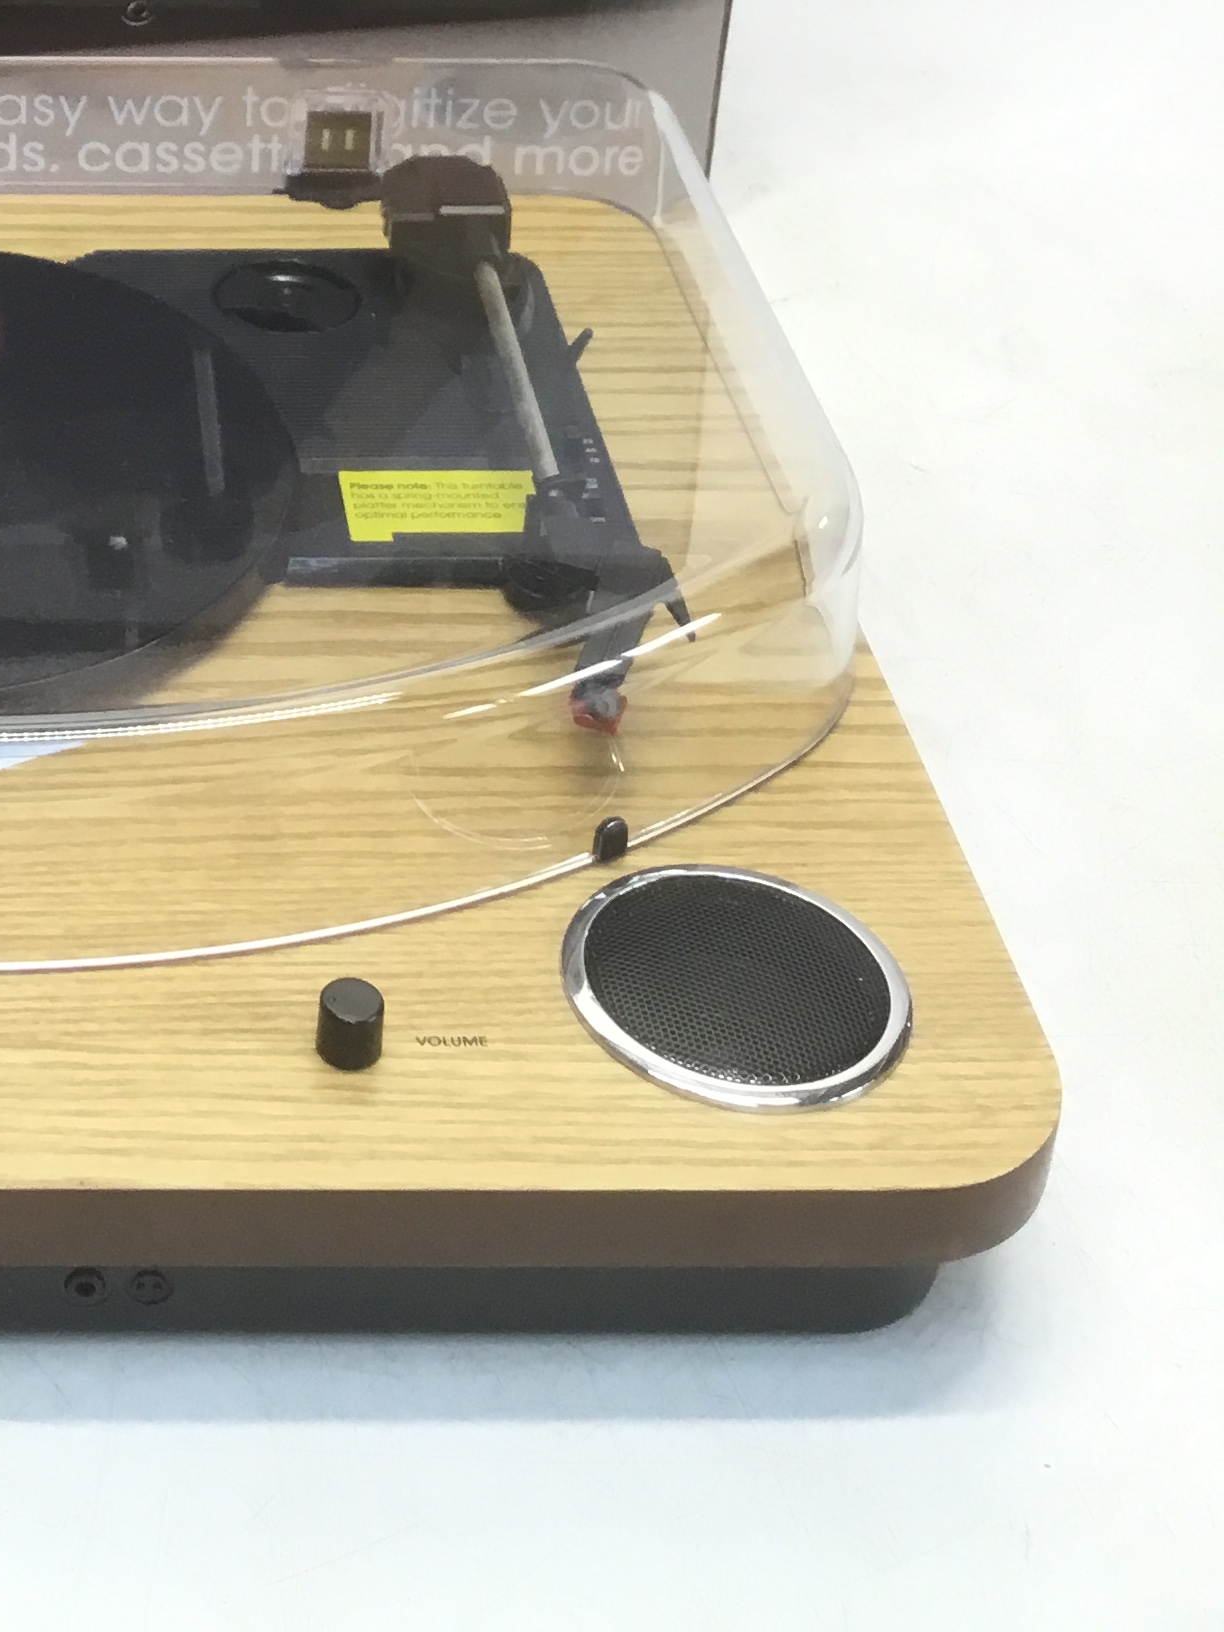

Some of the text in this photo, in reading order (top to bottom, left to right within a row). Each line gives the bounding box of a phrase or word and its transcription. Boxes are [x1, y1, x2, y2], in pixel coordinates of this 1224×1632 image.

[107, 93, 224, 137] way
[242, 85, 290, 128] to
[514, 143, 644, 176] more
[415, 1035, 488, 1047] VOLUME
